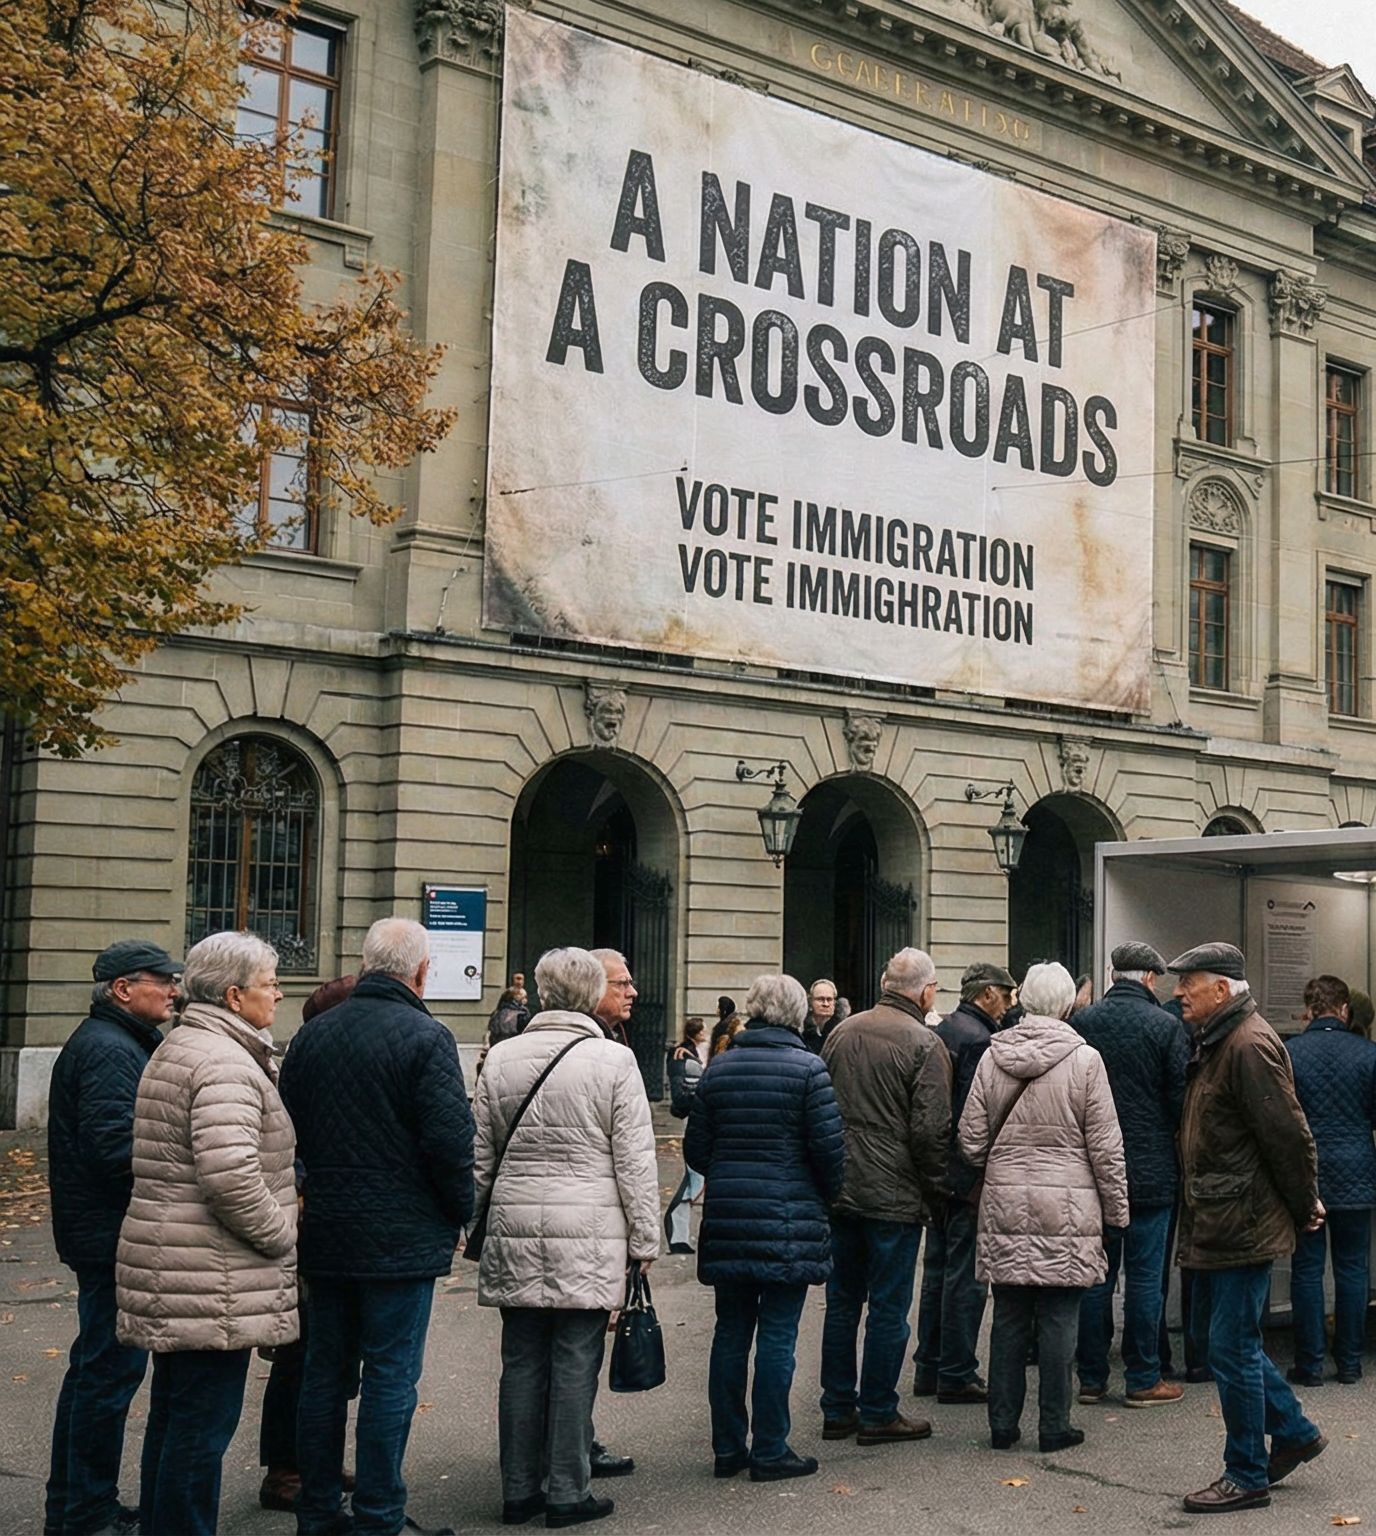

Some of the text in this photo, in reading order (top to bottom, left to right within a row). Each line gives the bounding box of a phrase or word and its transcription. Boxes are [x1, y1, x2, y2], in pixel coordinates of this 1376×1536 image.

[609, 149, 1075, 369] A NATION AT
[545, 258, 1119, 487] A CROSSROADS
[675, 476, 1035, 591] VOTE IMMIGRATION
[677, 543, 1033, 646] VOTE IMMIGHRATION
